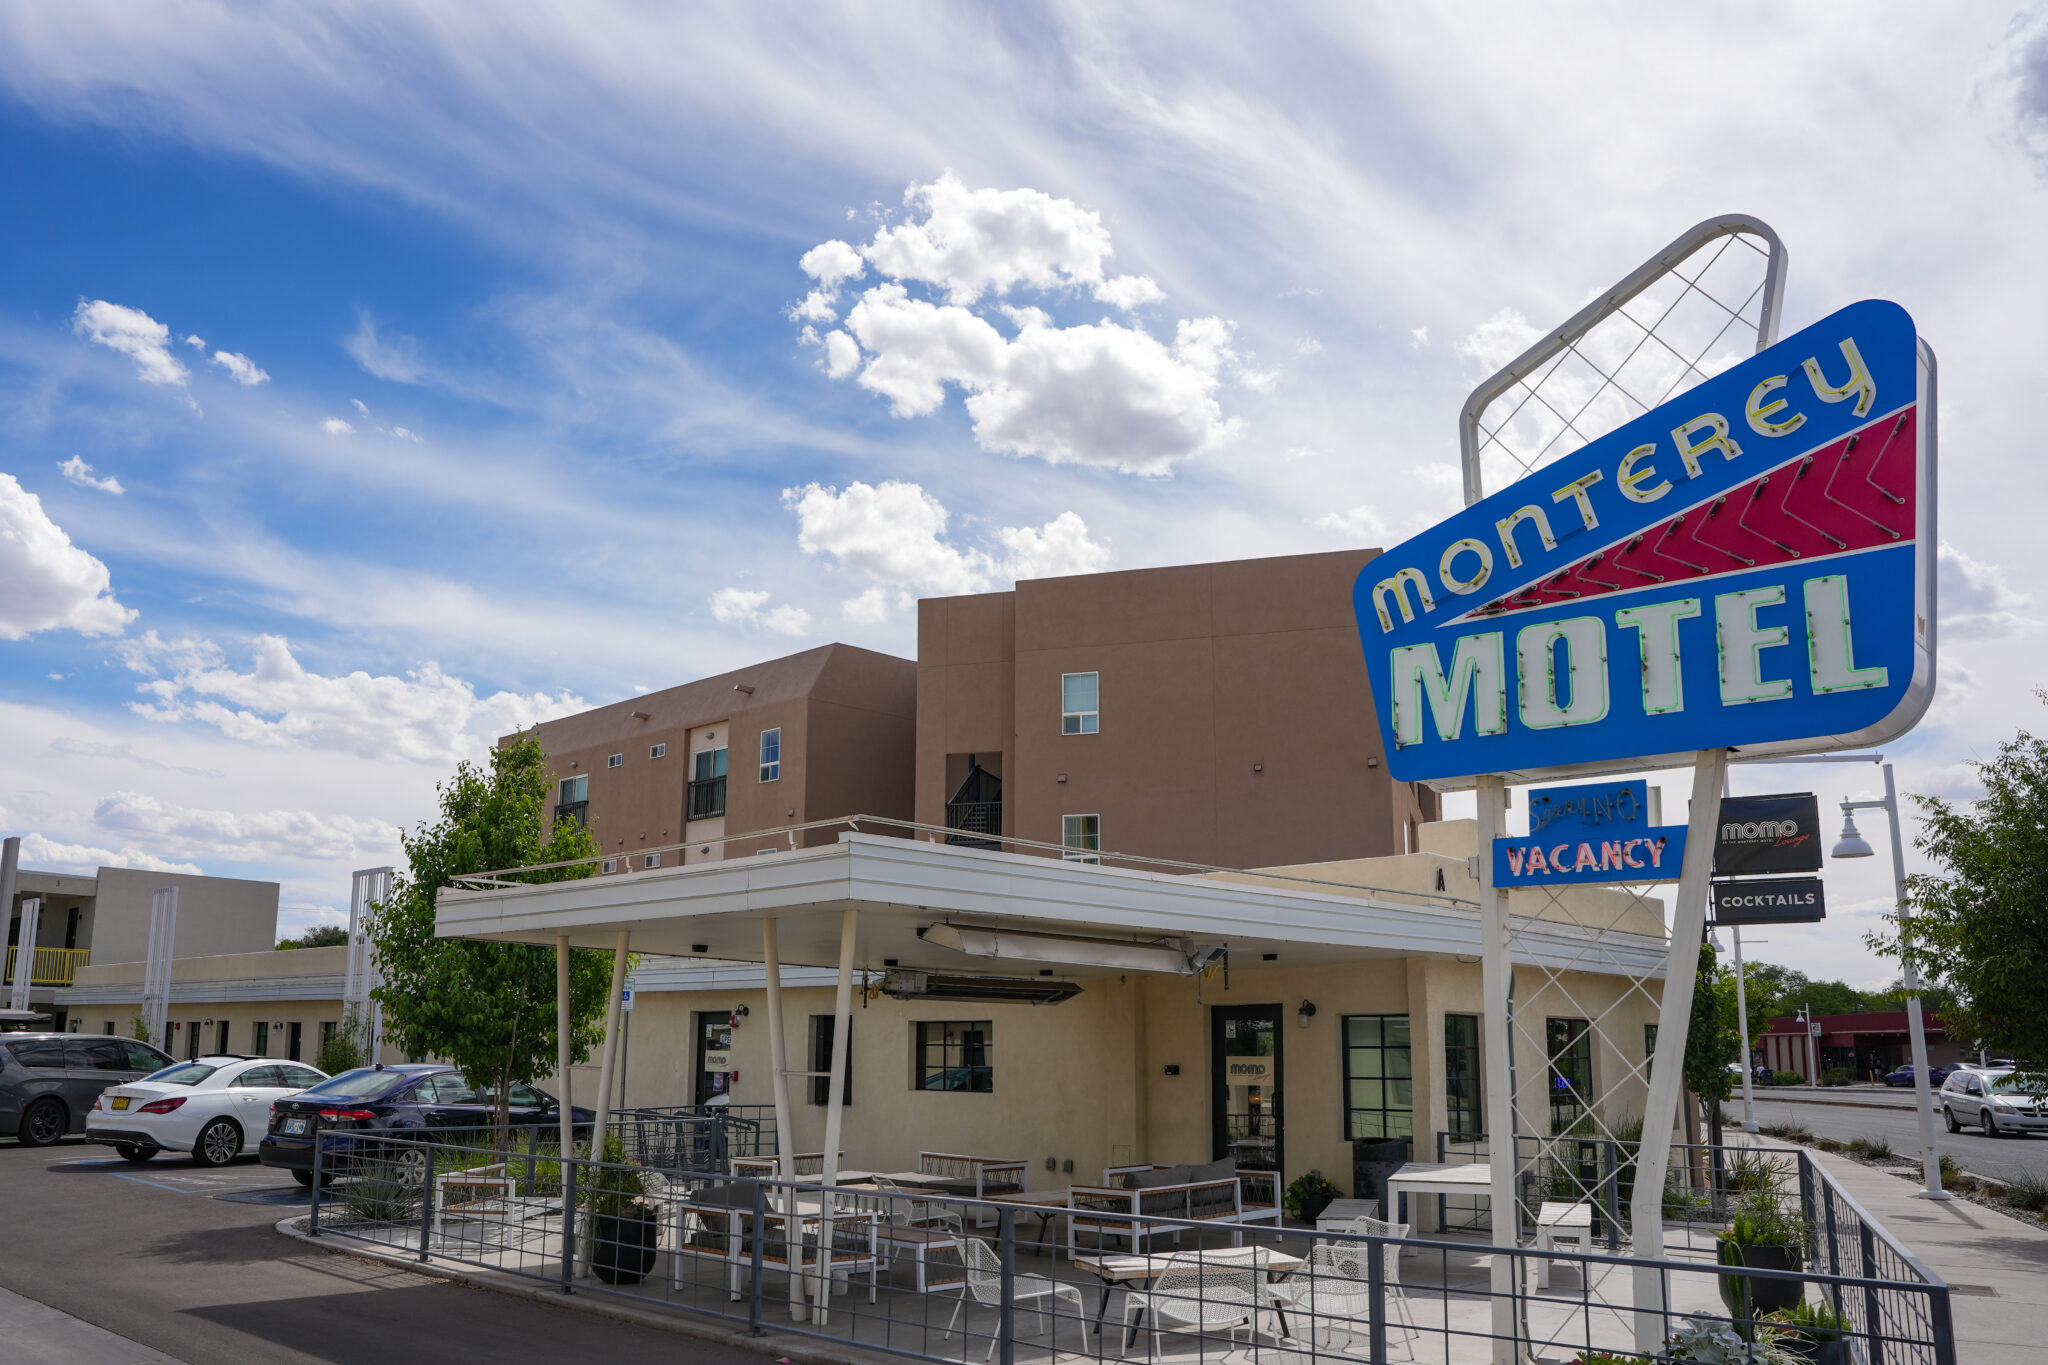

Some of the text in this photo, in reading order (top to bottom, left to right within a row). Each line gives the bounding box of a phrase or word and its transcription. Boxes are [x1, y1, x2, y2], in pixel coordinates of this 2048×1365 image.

[1390, 574, 1888, 750] MOTEL
[1592, 788, 1640, 824] NO
[1507, 838, 1666, 876] VACANCY
[1773, 832, 1809, 847] Lounge
[1721, 893, 1816, 908] COCKTAILS
